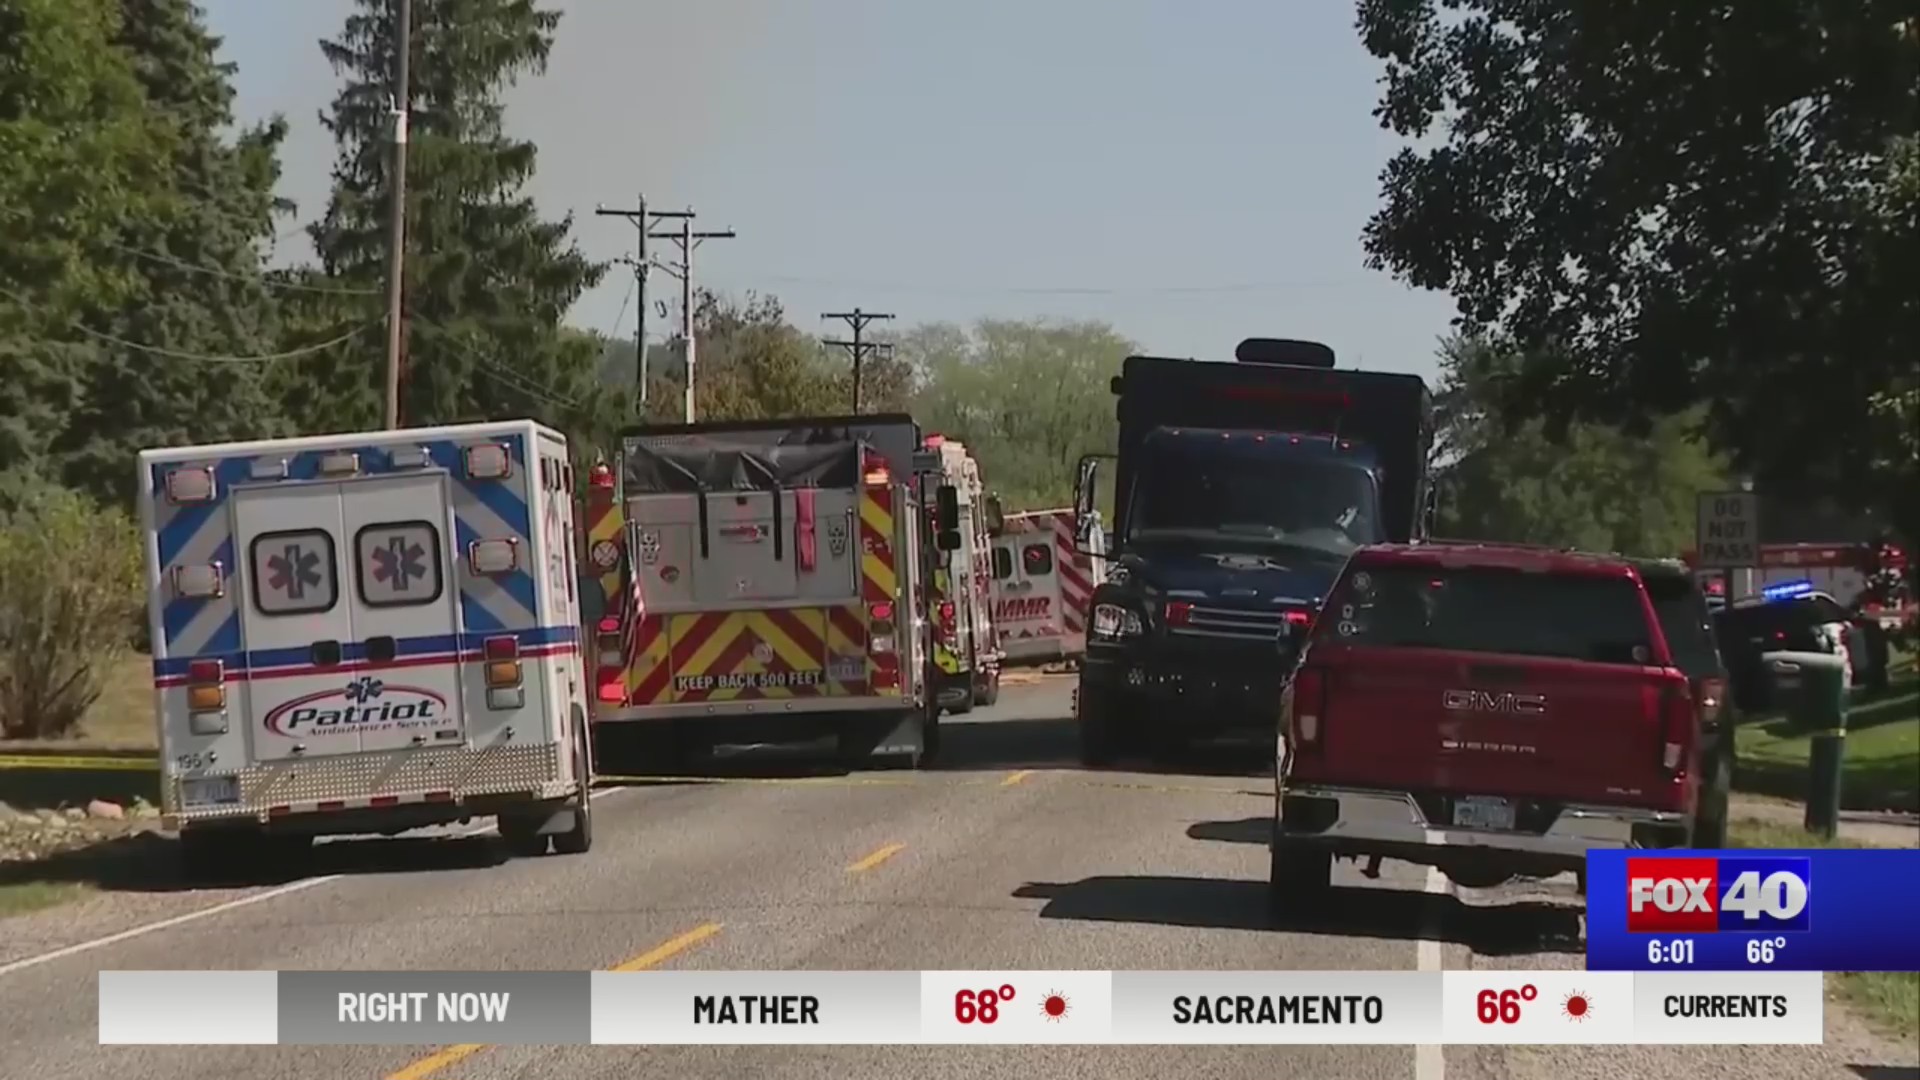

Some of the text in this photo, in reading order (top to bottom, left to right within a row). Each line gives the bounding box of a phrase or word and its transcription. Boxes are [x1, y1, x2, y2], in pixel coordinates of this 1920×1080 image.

[1714, 499, 1741, 516] DO
[1708, 521, 1746, 538] NOT
[1703, 543, 1753, 560] PASS
[995, 596, 1050, 618] MMR
[678, 671, 821, 691] KEEP BACK 500 FEET
[1443, 689, 1547, 714] GMC
[288, 700, 436, 729] Patriot
[178, 753, 202, 769] 196
